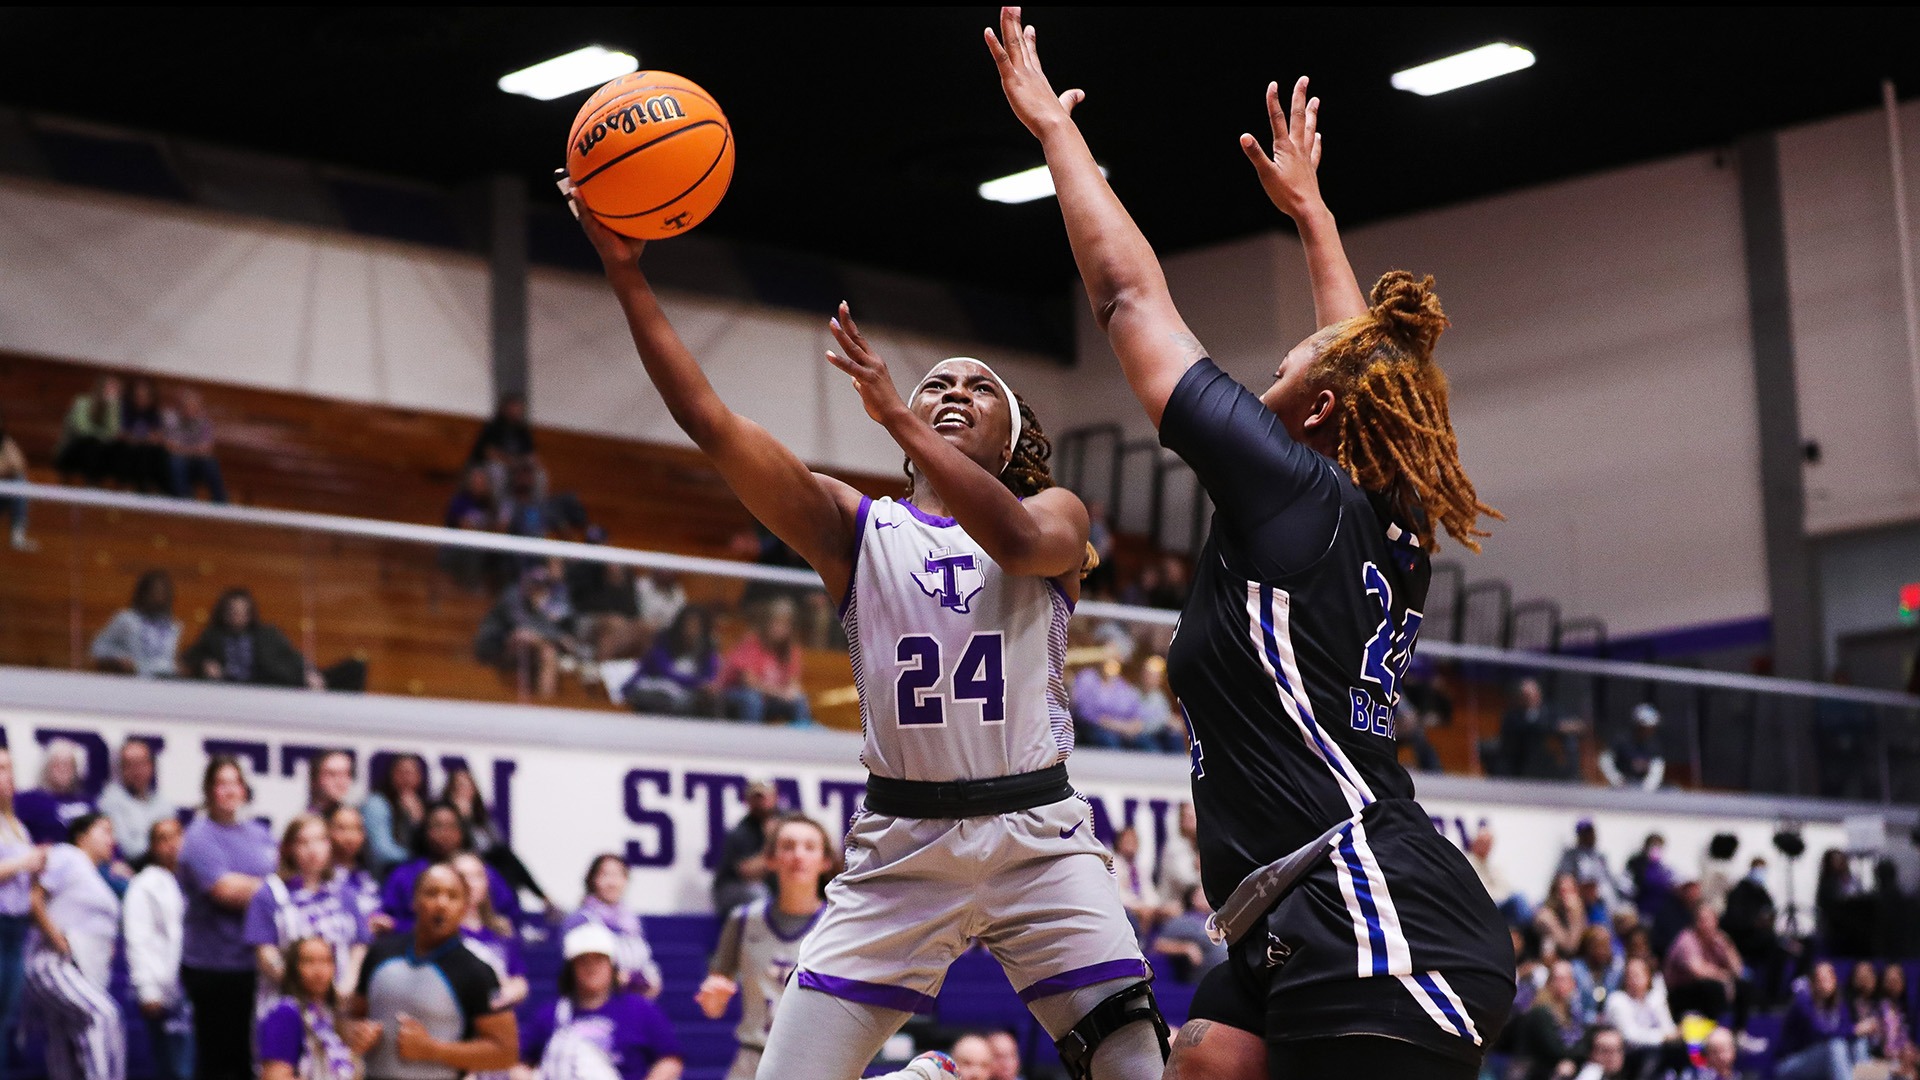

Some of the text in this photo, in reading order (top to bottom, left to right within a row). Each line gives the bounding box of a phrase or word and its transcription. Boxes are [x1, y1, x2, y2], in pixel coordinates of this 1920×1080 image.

[577, 93, 686, 157] Wilson
[924, 552, 976, 607] T
[894, 630, 1007, 729] 24
